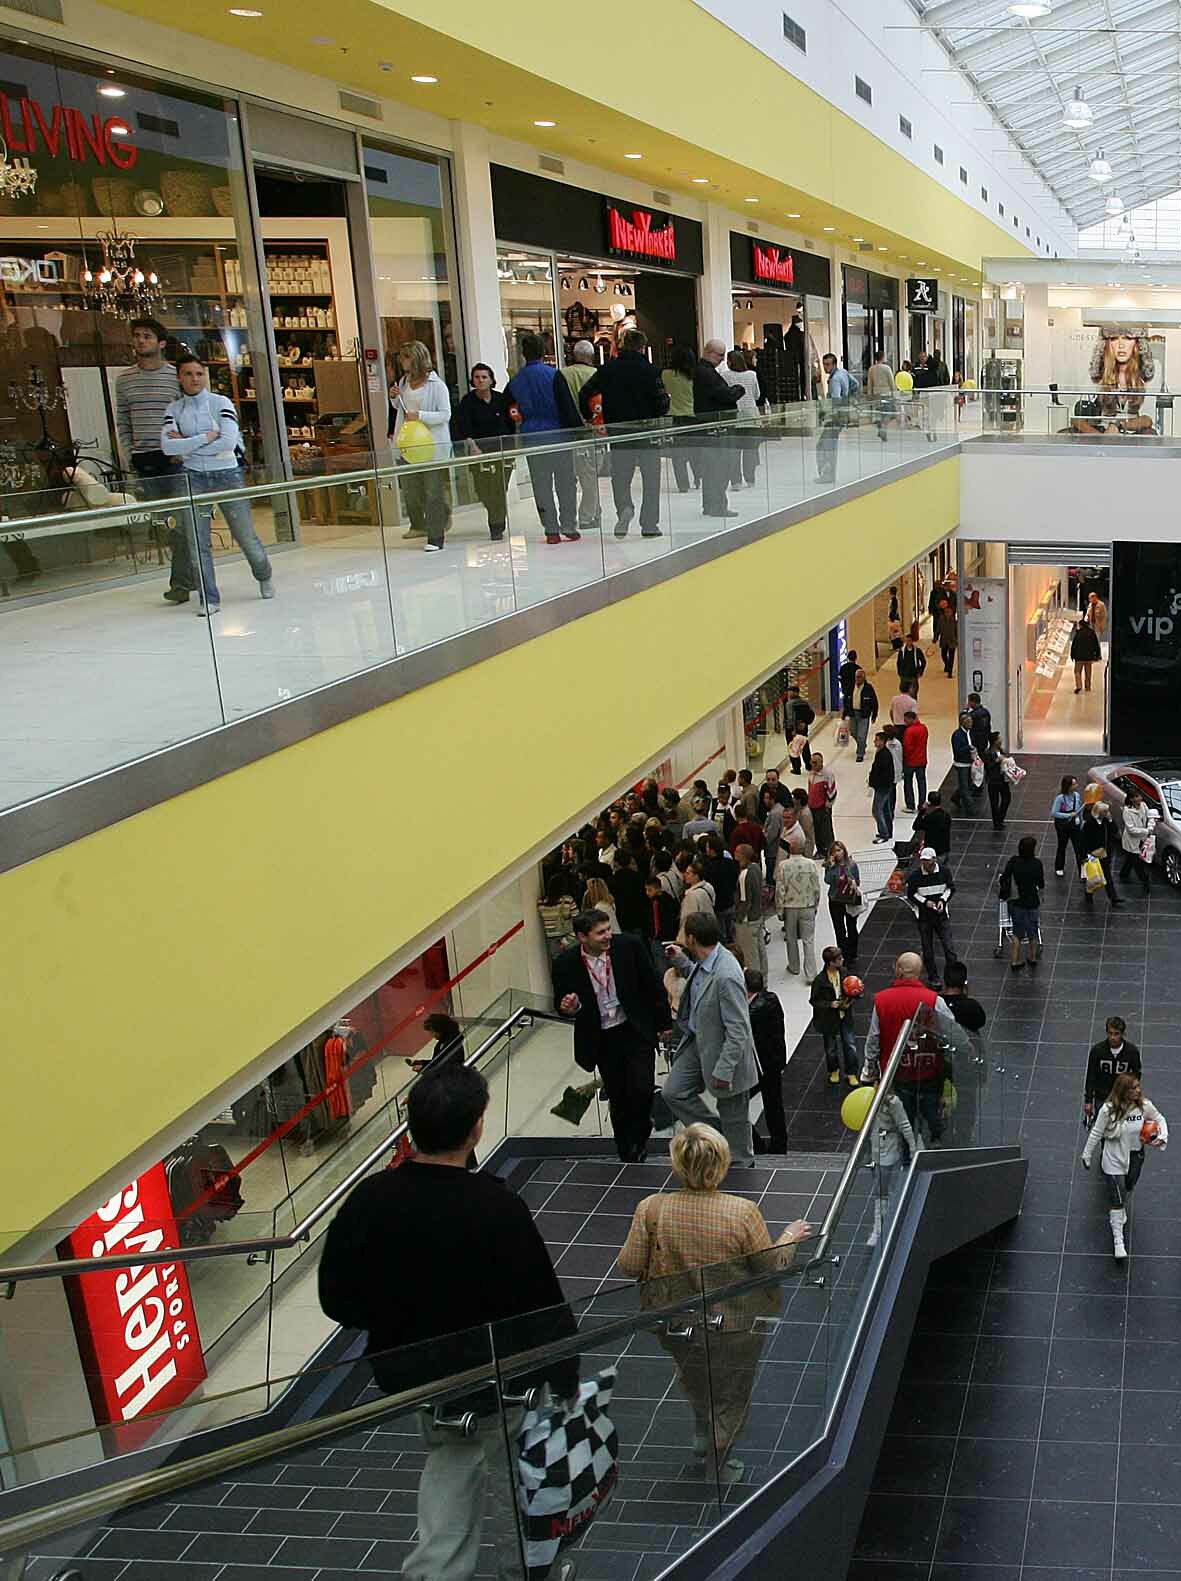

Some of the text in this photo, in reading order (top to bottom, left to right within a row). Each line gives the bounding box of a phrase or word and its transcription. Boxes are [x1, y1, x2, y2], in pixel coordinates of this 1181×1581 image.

[0, 91, 139, 169] LIVING
[1128, 608, 1174, 641] vip
[161, 1246, 190, 1351] SPORT
